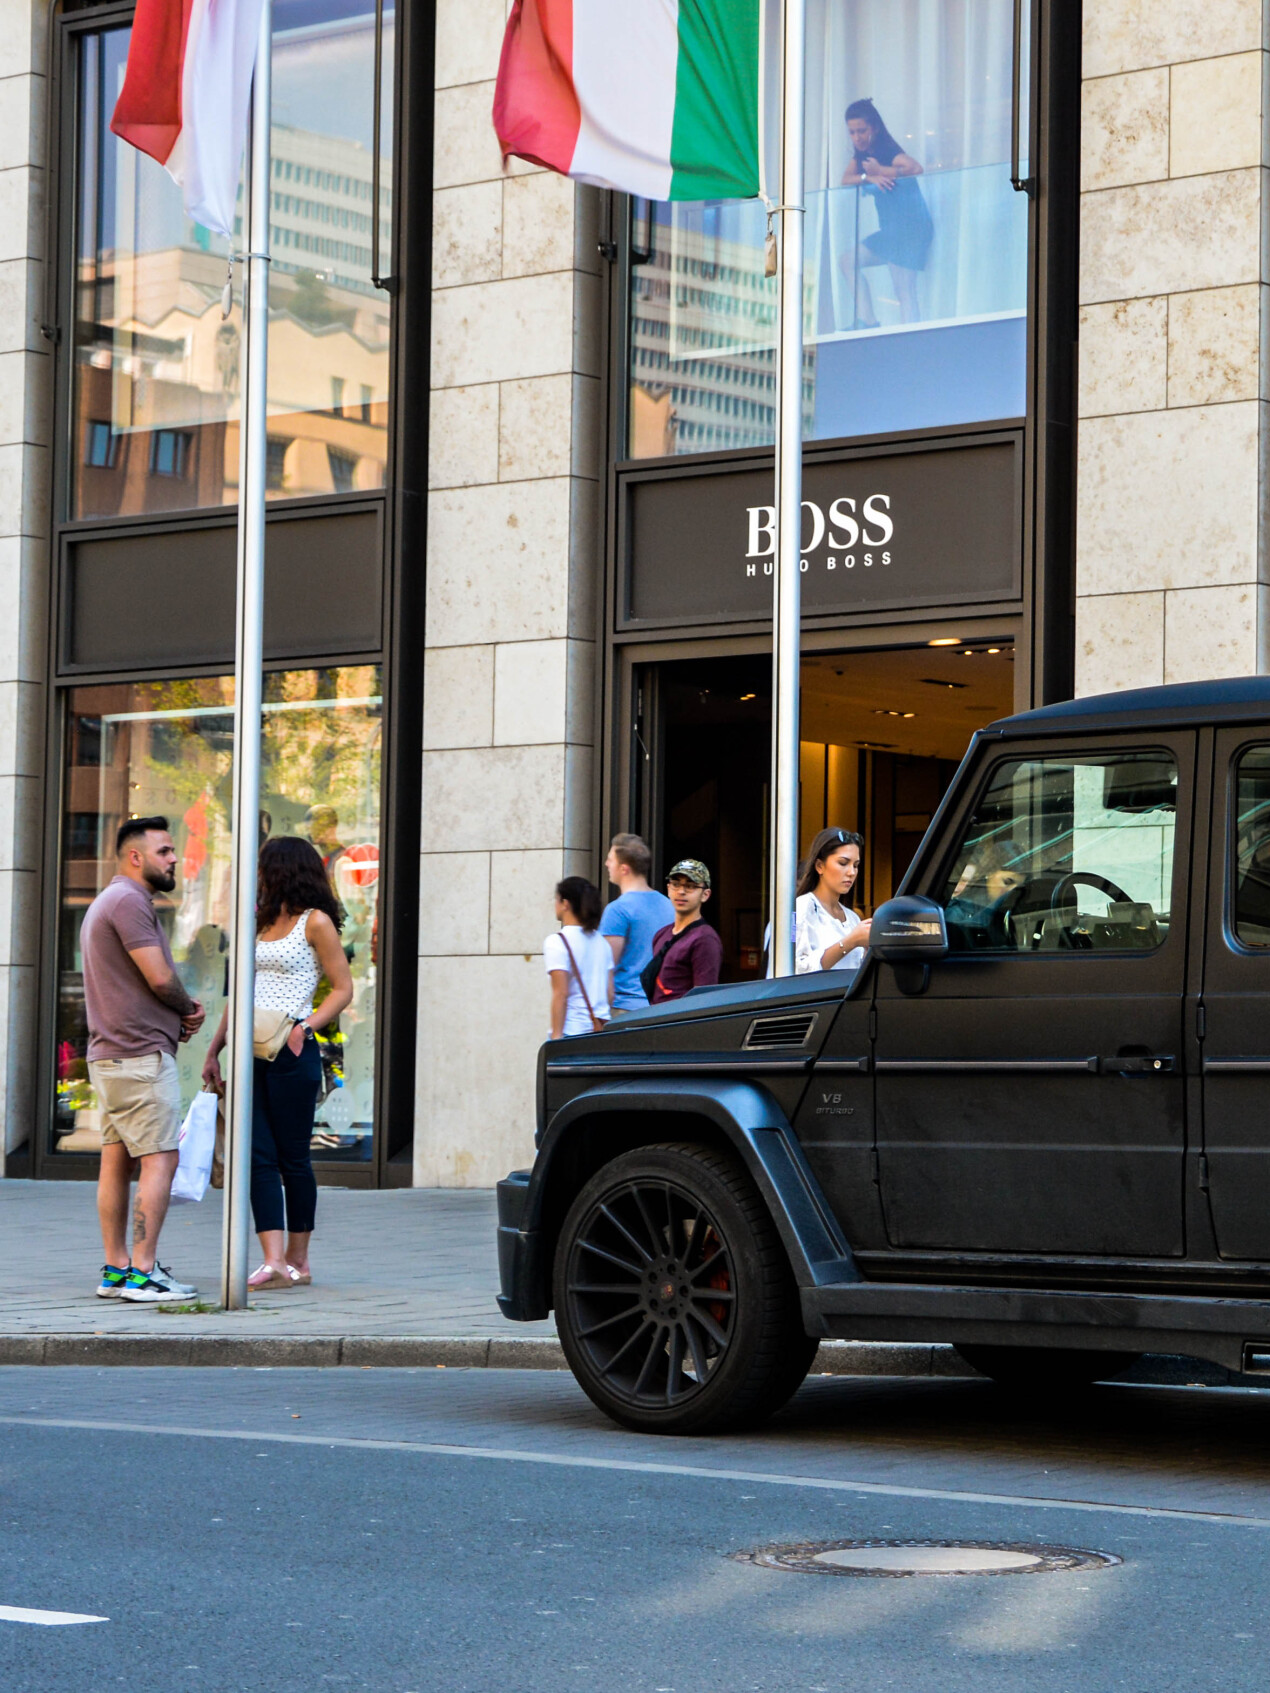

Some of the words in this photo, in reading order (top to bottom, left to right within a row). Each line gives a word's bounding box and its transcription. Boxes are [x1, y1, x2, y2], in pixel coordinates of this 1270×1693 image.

[745, 493, 894, 557] BOSS
[746, 559, 809, 577] HUO
[827, 551, 891, 570] BOSS
[822, 1093, 842, 1104] V8
